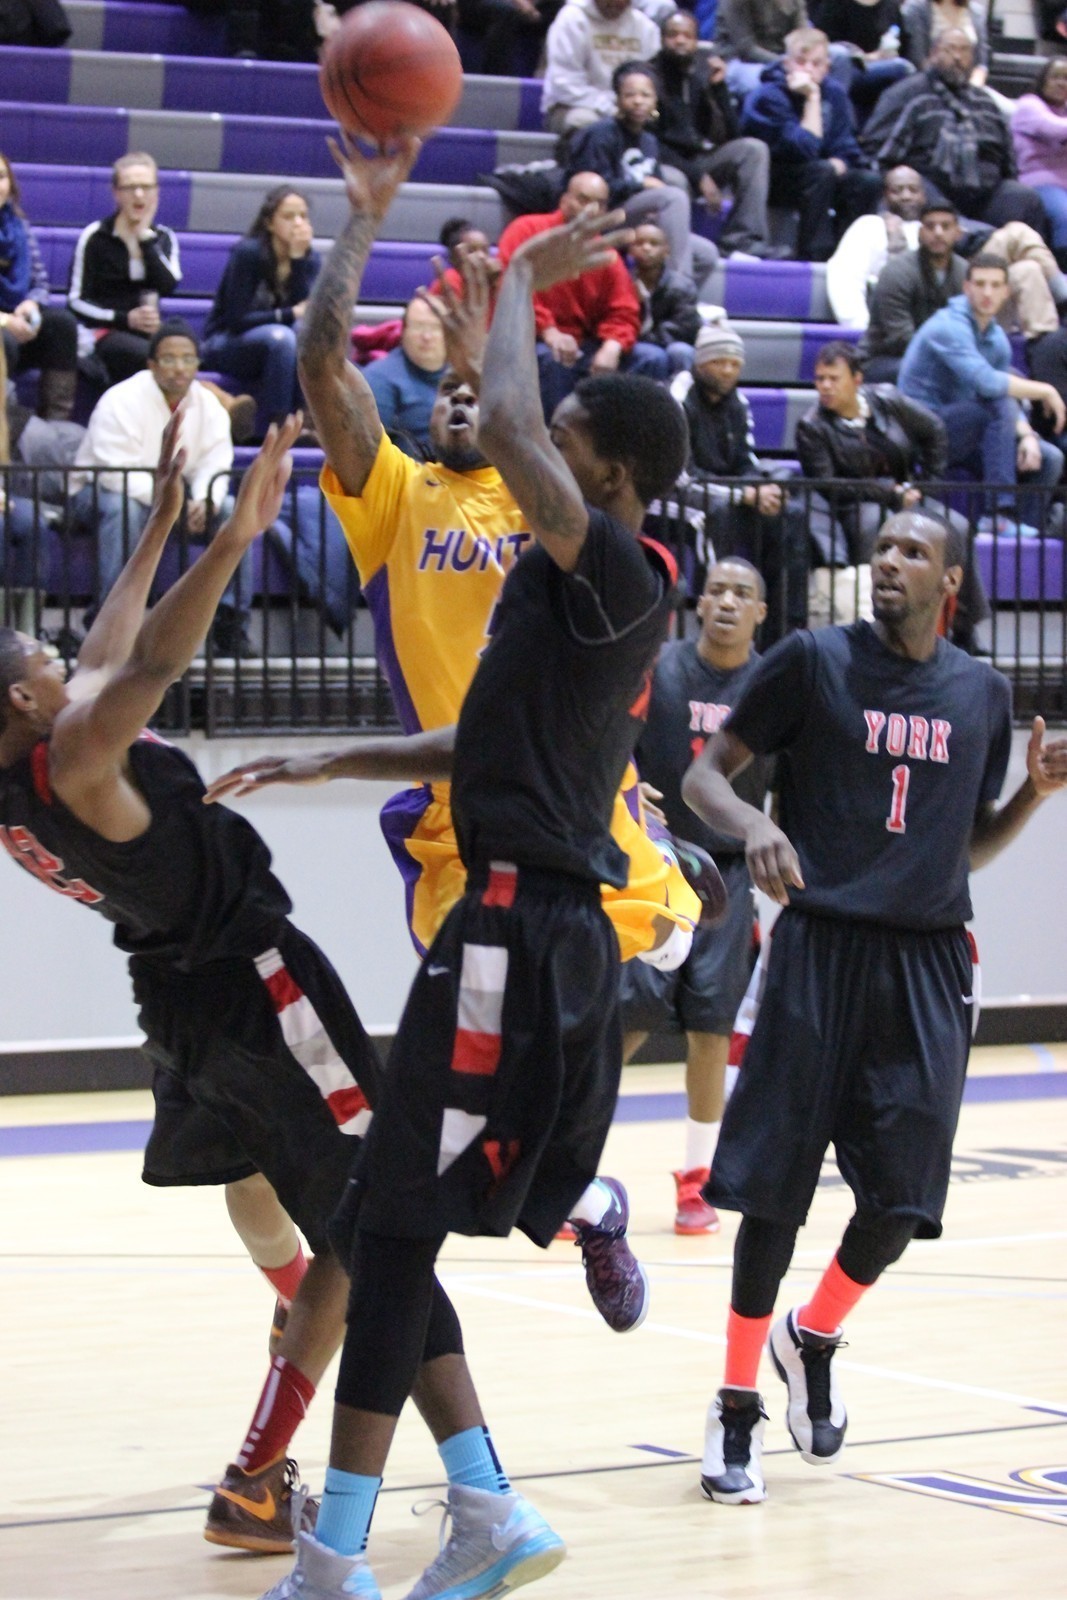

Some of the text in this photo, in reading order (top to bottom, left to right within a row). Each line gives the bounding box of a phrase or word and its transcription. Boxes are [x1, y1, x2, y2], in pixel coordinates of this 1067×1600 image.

[418, 529, 532, 571] HUNT
[864, 710, 951, 764] YORK
[886, 764, 910, 834] 1
